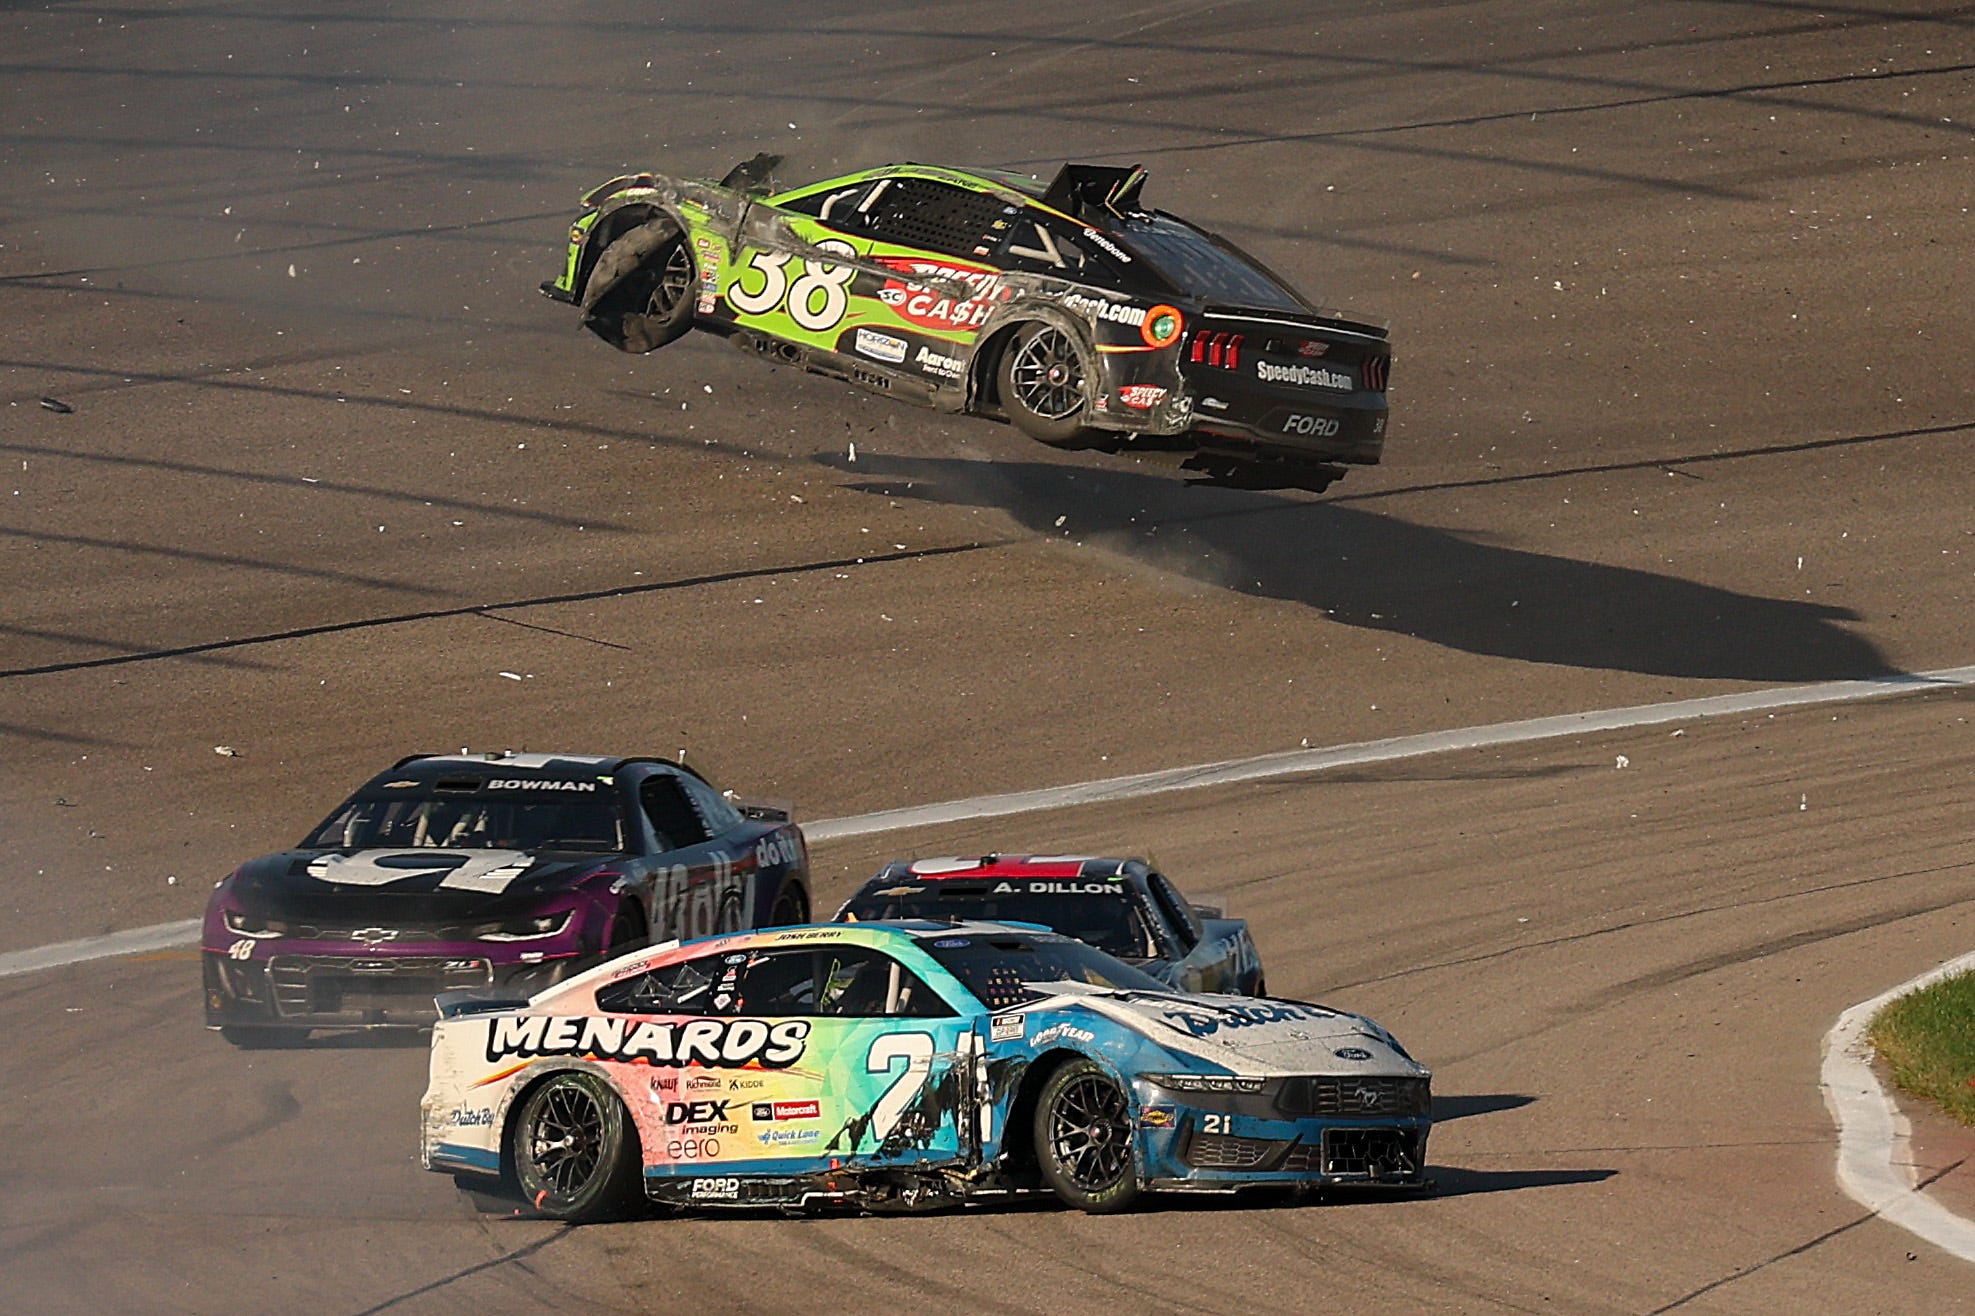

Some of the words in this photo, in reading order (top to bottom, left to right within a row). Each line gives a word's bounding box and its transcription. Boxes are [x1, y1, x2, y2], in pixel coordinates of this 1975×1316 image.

[728, 238, 858, 332] 38
[1257, 361, 1353, 391] SpeedyCash.com
[1282, 414, 1340, 437] FORD
[487, 779, 596, 792] BOWMAN
[993, 882, 1021, 893] A.
[1029, 882, 1124, 894] DILLON
[228, 939, 256, 960] 48
[486, 1016, 812, 1067] MENARDS
[666, 1099, 731, 1125] DEX
[775, 1104, 818, 1116] Motorcraft
[682, 1123, 738, 1135] imaging
[1203, 1114, 1231, 1134] 21
[667, 1138, 721, 1159] eero
[692, 1178, 741, 1192] FORD
